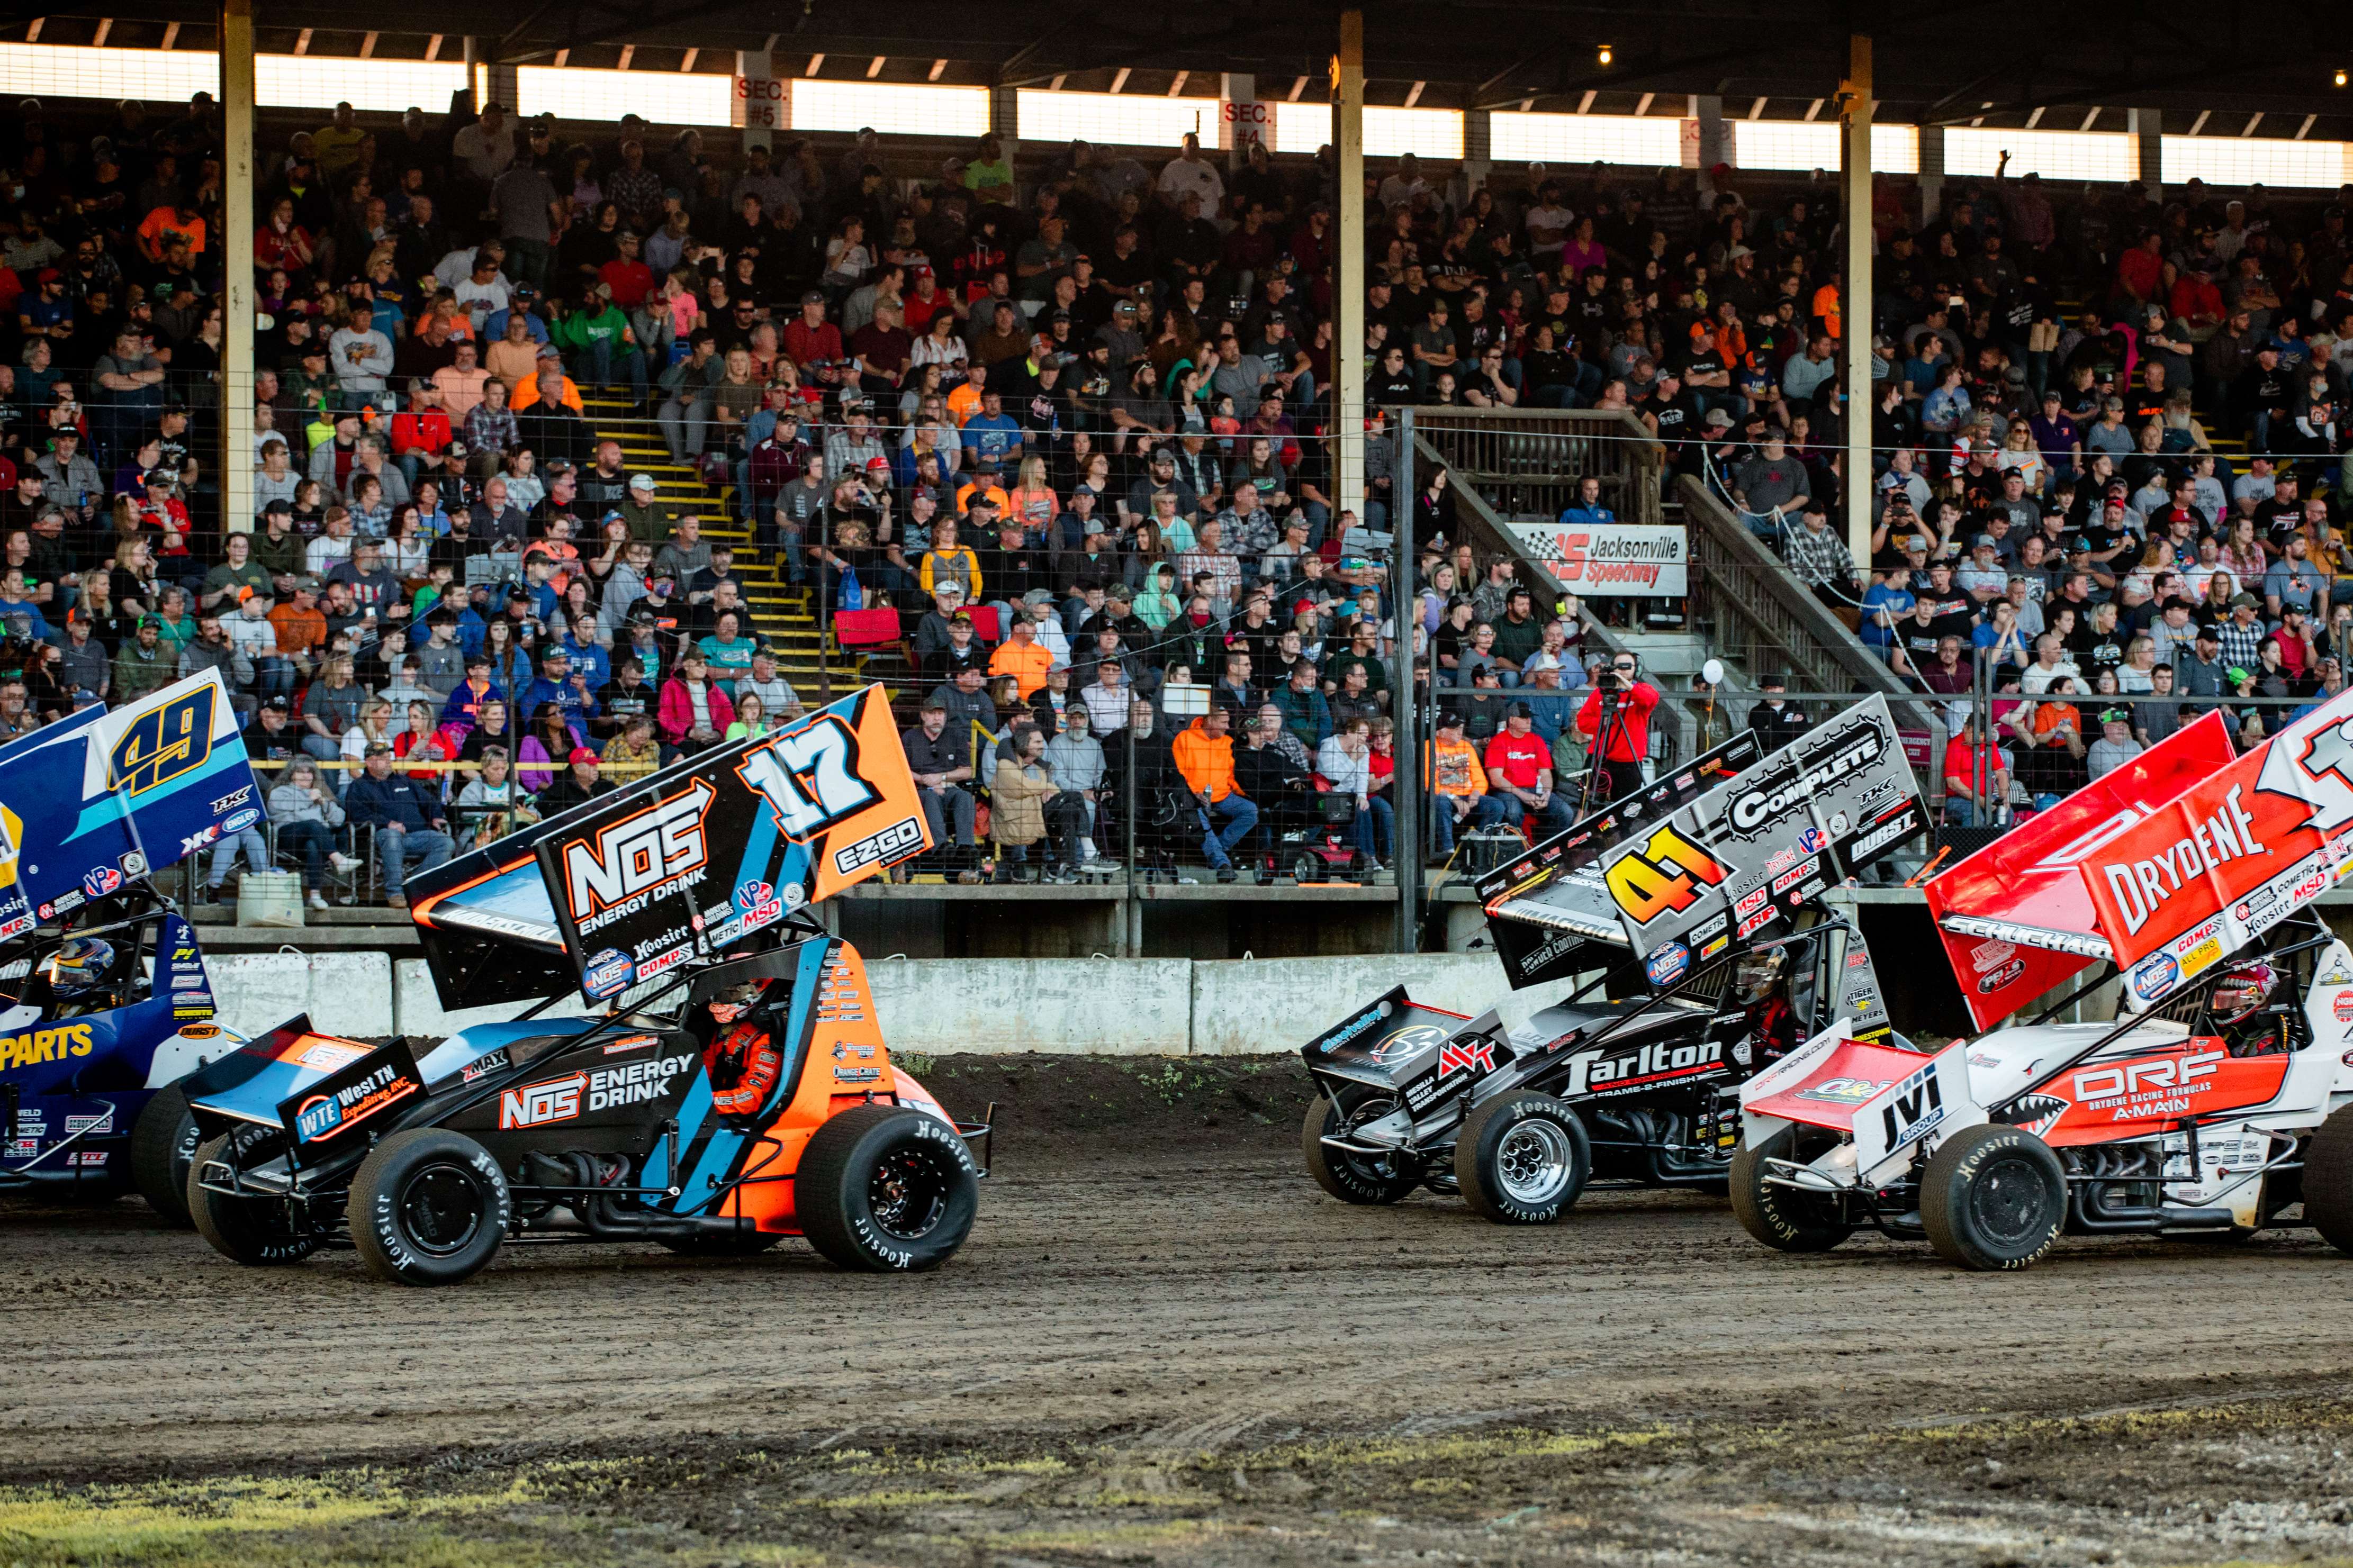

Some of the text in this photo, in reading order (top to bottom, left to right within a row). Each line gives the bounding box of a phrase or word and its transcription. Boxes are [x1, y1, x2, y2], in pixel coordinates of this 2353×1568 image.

[738, 79, 787, 101] SEC.
[751, 106, 775, 125] #5
[1224, 103, 1272, 123] SEC.
[1591, 535, 1679, 559] Jacksonville
[1586, 560, 1661, 589] Speedway
[106, 682, 218, 798] 49
[1835, 731, 1875, 757] SOLUTIONS
[740, 717, 874, 837] 17
[226, 810, 257, 830] ENGLER
[1852, 810, 1915, 857] DURST
[567, 782, 712, 918] NOS
[836, 820, 919, 872] EZGO
[1765, 847, 1797, 875] DRYDENE
[2104, 783, 2265, 937] DRYDENE
[1605, 826, 1729, 923] 41
[1775, 864, 1809, 891] COMP
[2277, 863, 2314, 893] COMETIC
[2294, 873, 2325, 903] MSD
[579, 867, 708, 936] ENERGY DRINK
[744, 900, 780, 928] MSD
[1736, 889, 1764, 917] MSD
[1691, 917, 1726, 942] COMETIC
[1737, 905, 1776, 938] ARP
[2245, 900, 2289, 938] Hoosier
[633, 926, 688, 962] Hoosier
[2178, 923, 2215, 953] COMP
[2182, 939, 2215, 965] ALL PRO
[639, 950, 680, 977] COMP
[1850, 987, 1872, 1000] TIGER
[1852, 1009, 1883, 1023] MEYERS
[179, 1027, 218, 1036] DURST
[1853, 1027, 1890, 1041] ONESTOWN
[0, 1023, 93, 1071] PARTS
[590, 1053, 695, 1092] ENERGY
[1559, 1040, 1723, 1098] Tarlton
[2073, 1050, 2224, 1102] DRF
[337, 1064, 396, 1107] West TN
[501, 1072, 588, 1129] NOS
[589, 1078, 672, 1111] DRINK
[1406, 1076, 1436, 1098] MESILLA
[1408, 1085, 1433, 1105] VALLEY
[1412, 1073, 1468, 1112] TRANSPORTATION
[1597, 1076, 1697, 1098] FRAME-2-FINISH
[2088, 1082, 2211, 1110] DRYDENE RACING FORMULAS
[300, 1103, 336, 1136] WTE
[1510, 1101, 1573, 1123] Hoosier
[1882, 1074, 1942, 1155] JVI
[1903, 1110, 1940, 1140] GROUP
[915, 1120, 973, 1172] Hoosier
[1958, 1136, 2020, 1183] Hoosier
[1333, 1164, 1389, 1201] Hoosier
[1499, 1201, 1558, 1221] Hoosier
[376, 1194, 416, 1271] Hoosier
[854, 1218, 913, 1269] Hoosier
[2002, 1222, 2060, 1269] Hoosier
